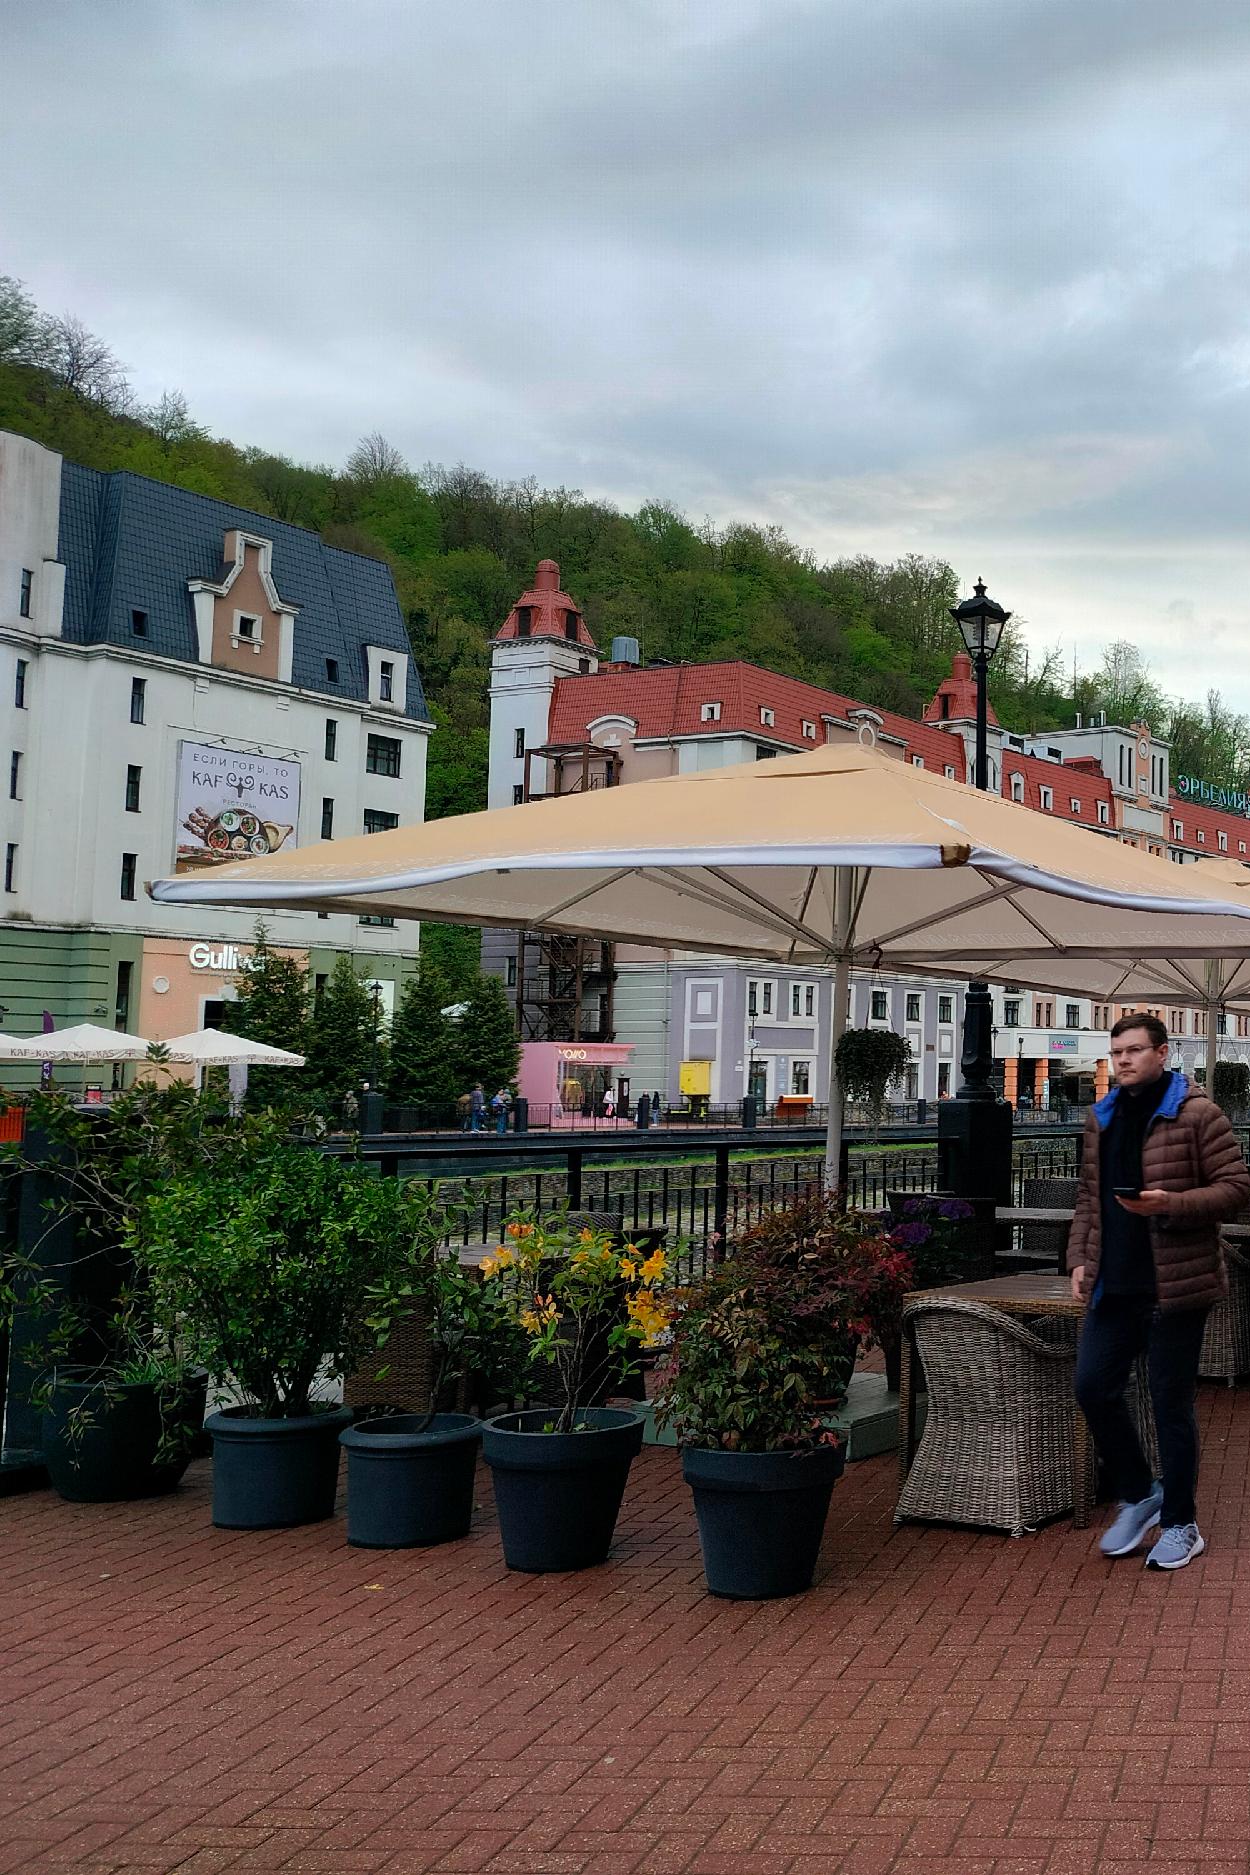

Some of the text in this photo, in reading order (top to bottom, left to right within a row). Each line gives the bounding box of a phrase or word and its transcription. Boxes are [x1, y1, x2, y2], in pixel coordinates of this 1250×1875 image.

[193, 753, 227, 767] ЕСЛИ
[273, 768, 289, 778] ТО
[192, 771, 289, 800] KAF KAS
